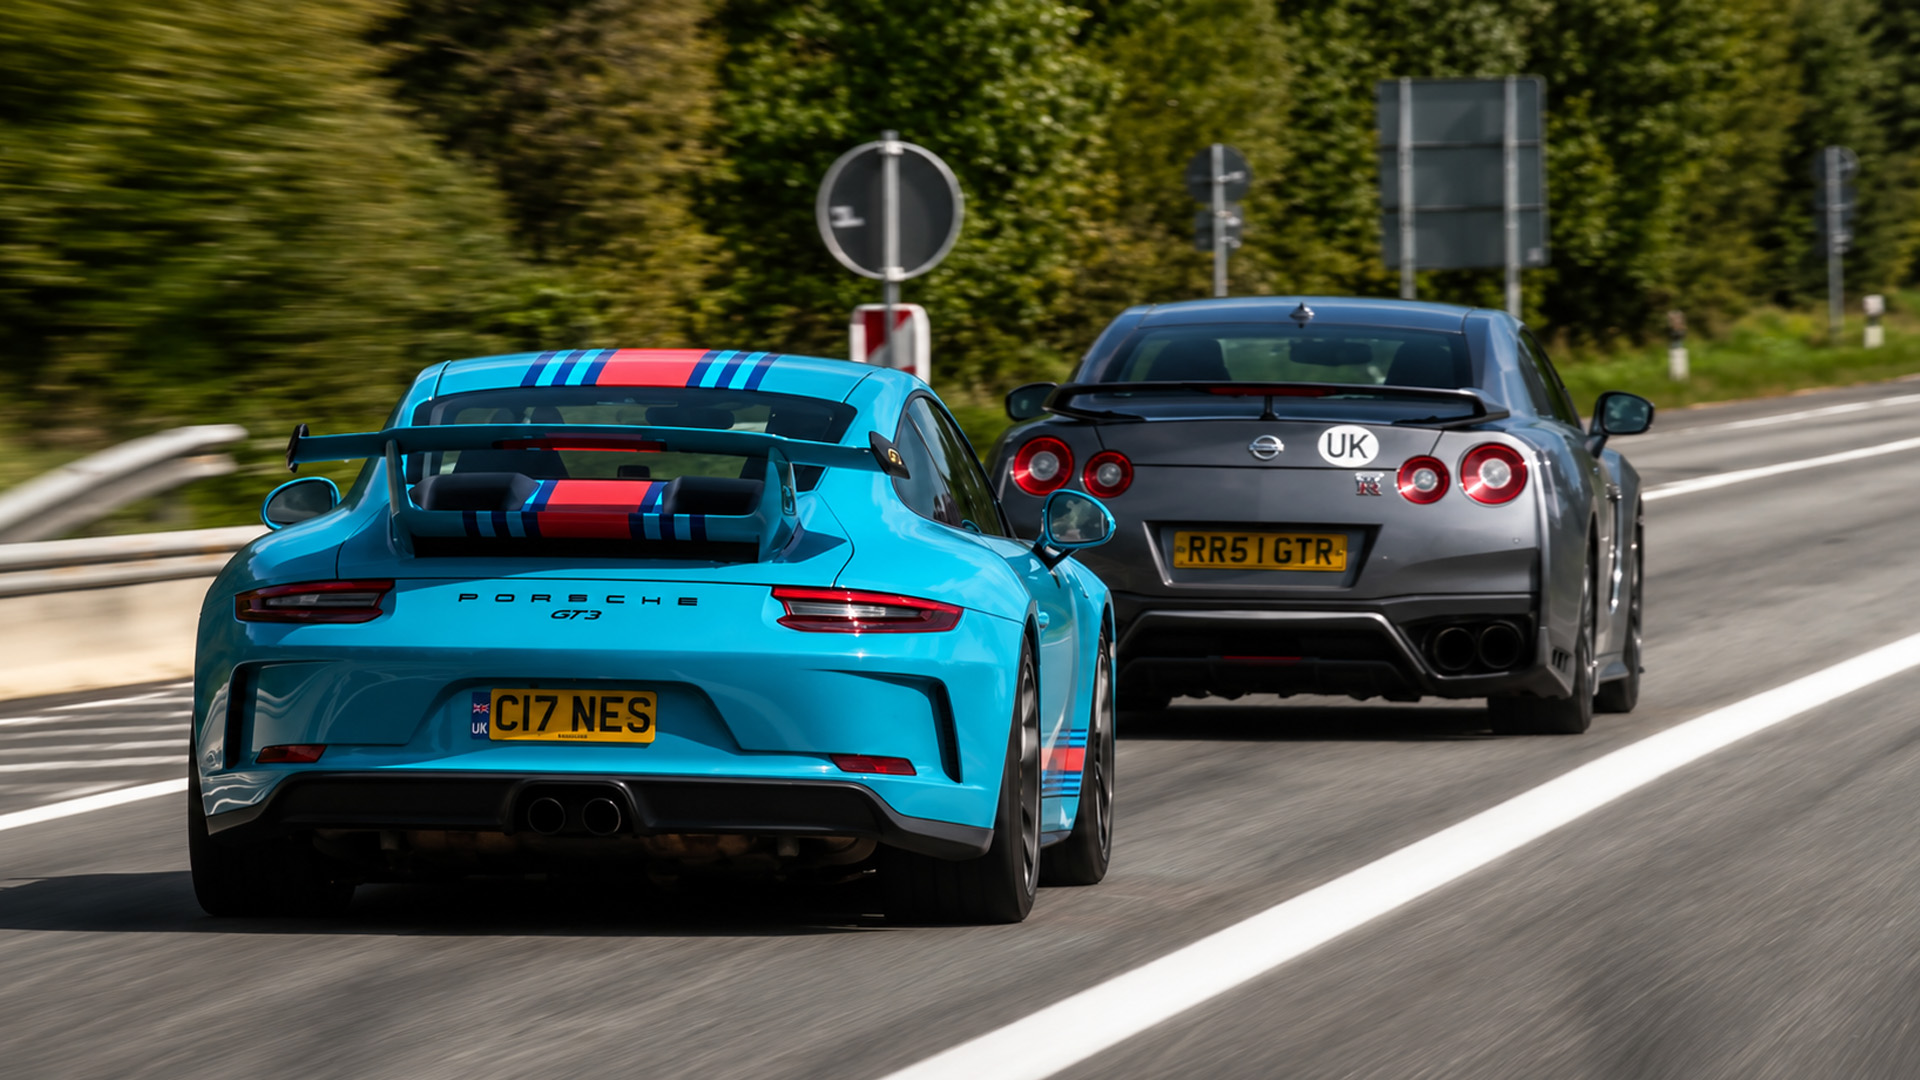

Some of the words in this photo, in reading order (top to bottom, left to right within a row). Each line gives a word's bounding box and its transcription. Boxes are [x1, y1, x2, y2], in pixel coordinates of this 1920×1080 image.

[1326, 433, 1369, 459] UK
[1274, 537, 1333, 565] GTR
[458, 593, 698, 606] PORSCHE
[550, 609, 602, 620] GT3
[572, 696, 652, 733] NES
[471, 722, 488, 735] UK
